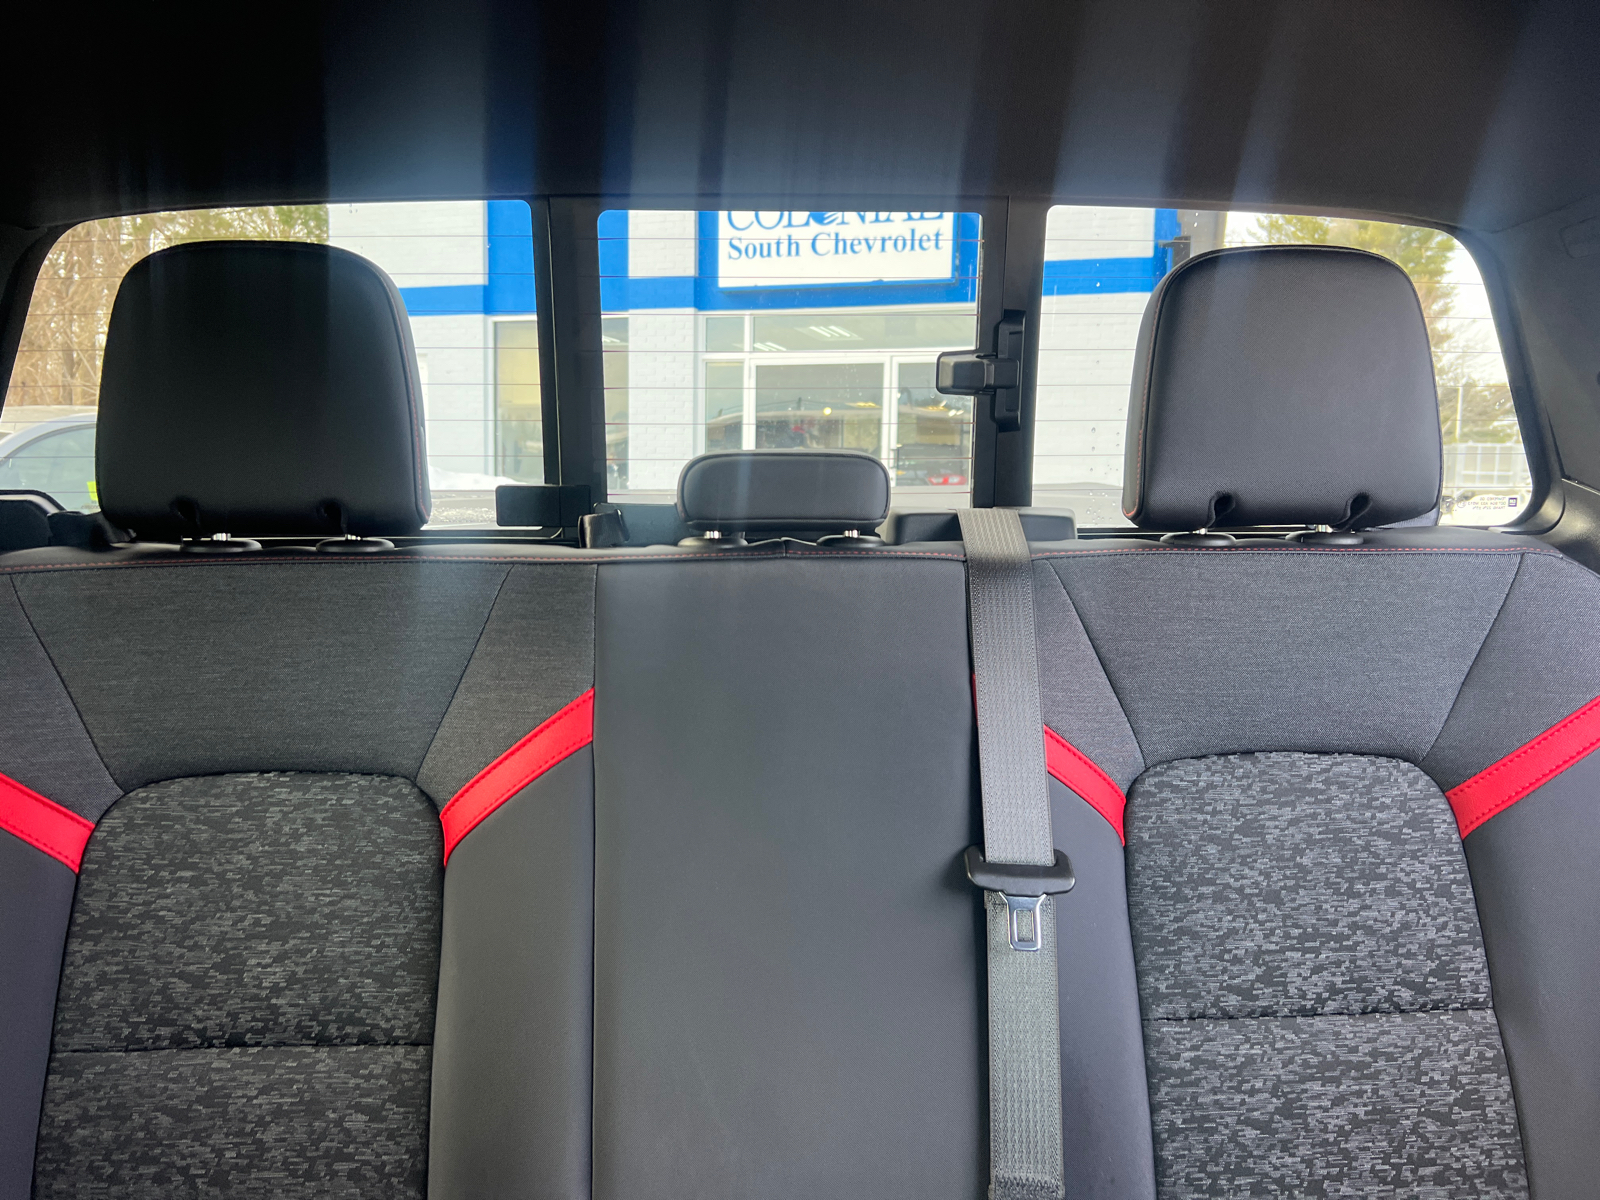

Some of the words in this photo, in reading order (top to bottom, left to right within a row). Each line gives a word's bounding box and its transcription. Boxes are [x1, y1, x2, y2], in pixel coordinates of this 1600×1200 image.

[727, 211, 944, 231] COLN
[728, 234, 801, 260] South
[811, 228, 944, 256] Chevrolet
